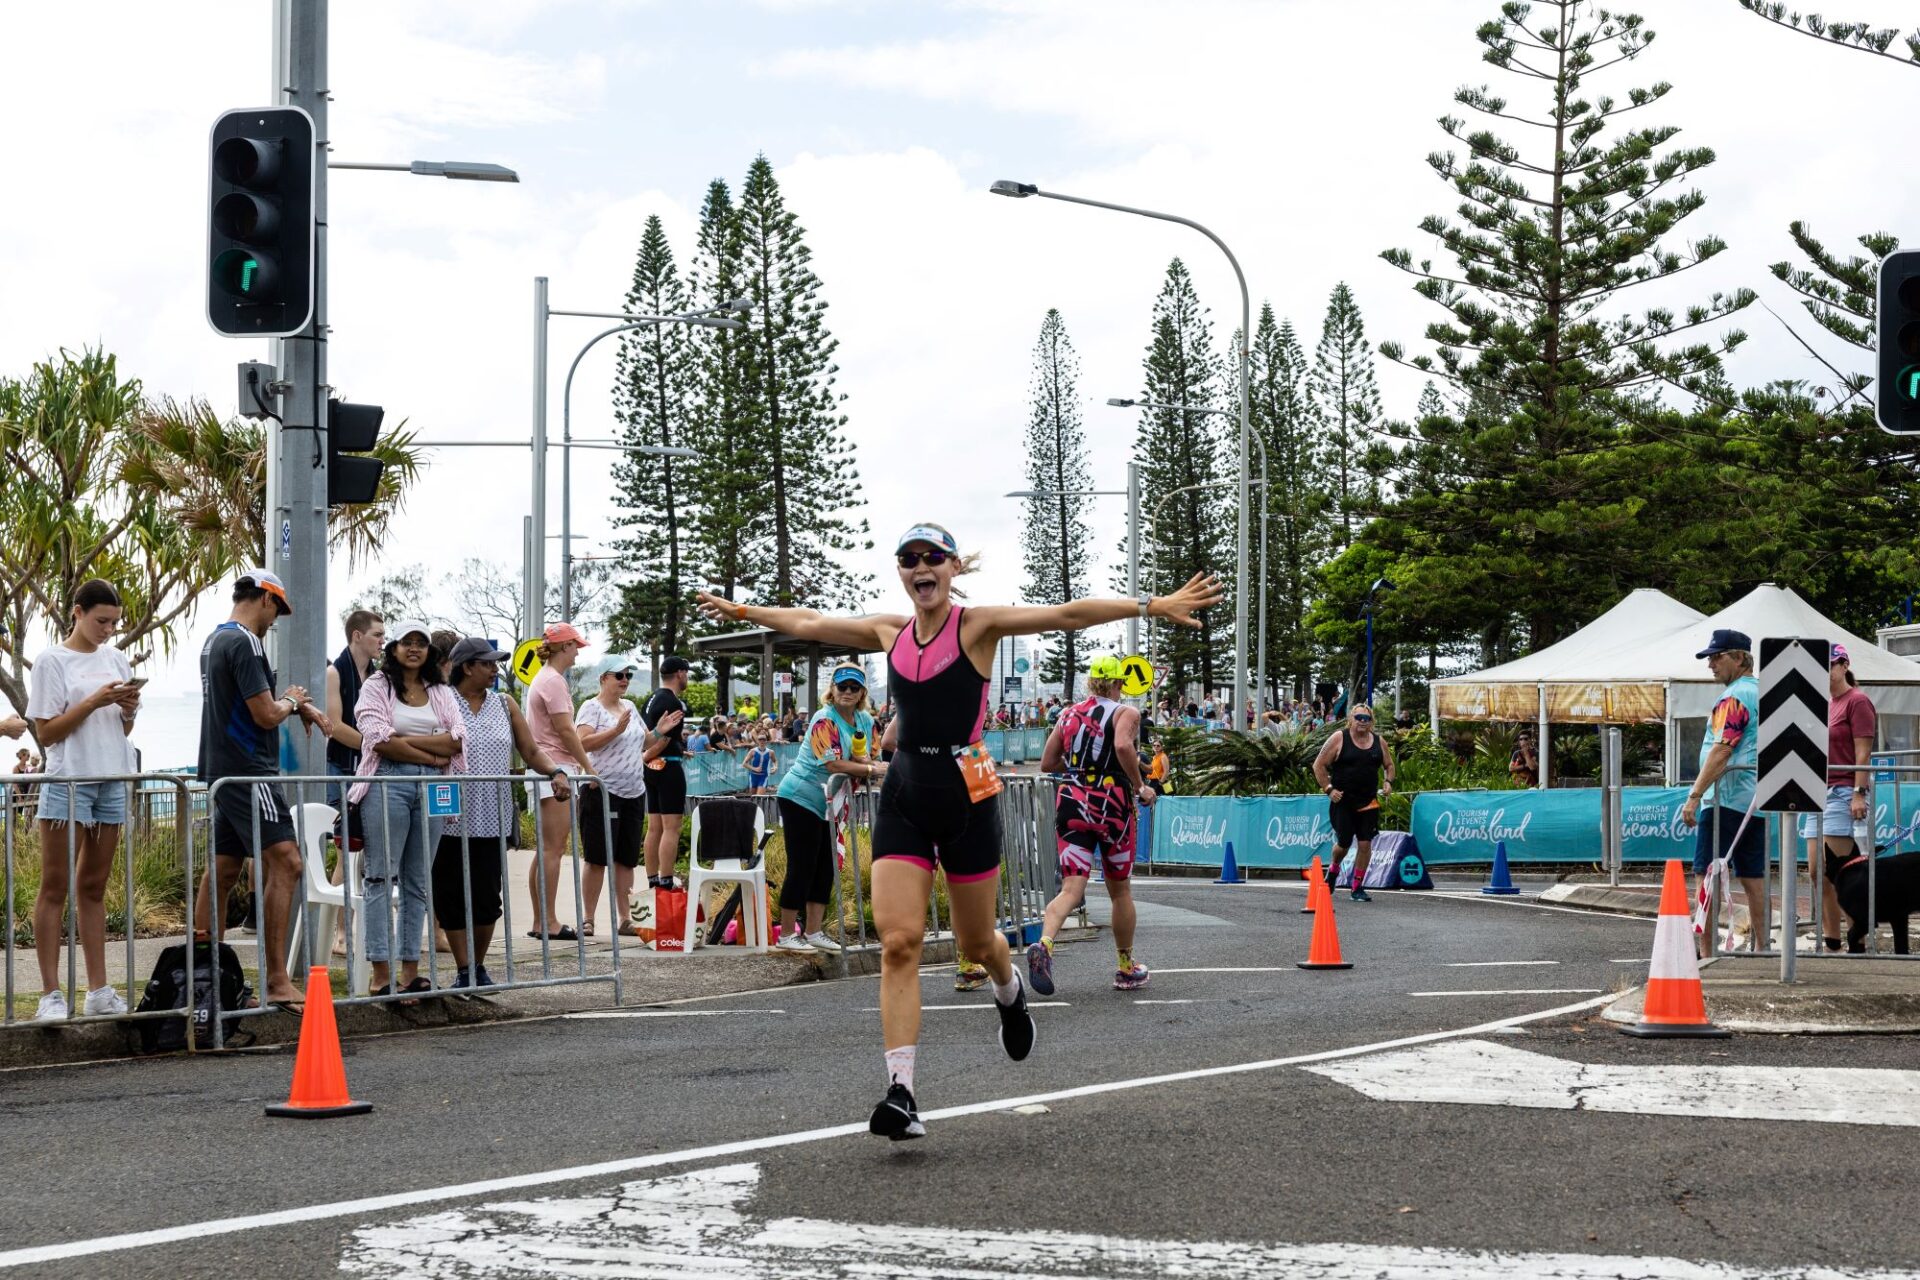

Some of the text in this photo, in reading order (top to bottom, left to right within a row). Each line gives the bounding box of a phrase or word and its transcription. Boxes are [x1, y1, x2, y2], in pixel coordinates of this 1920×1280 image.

[1457, 809, 1489, 818] TOURISM
[1629, 805, 1668, 814] TOURISM
[1285, 816, 1310, 824] TOURISM
[1456, 817, 1487, 825] & EVENTS
[1627, 813, 1667, 822] & EVENTS
[1434, 808, 1532, 845] Queensland
[1171, 815, 1227, 849] Queensland
